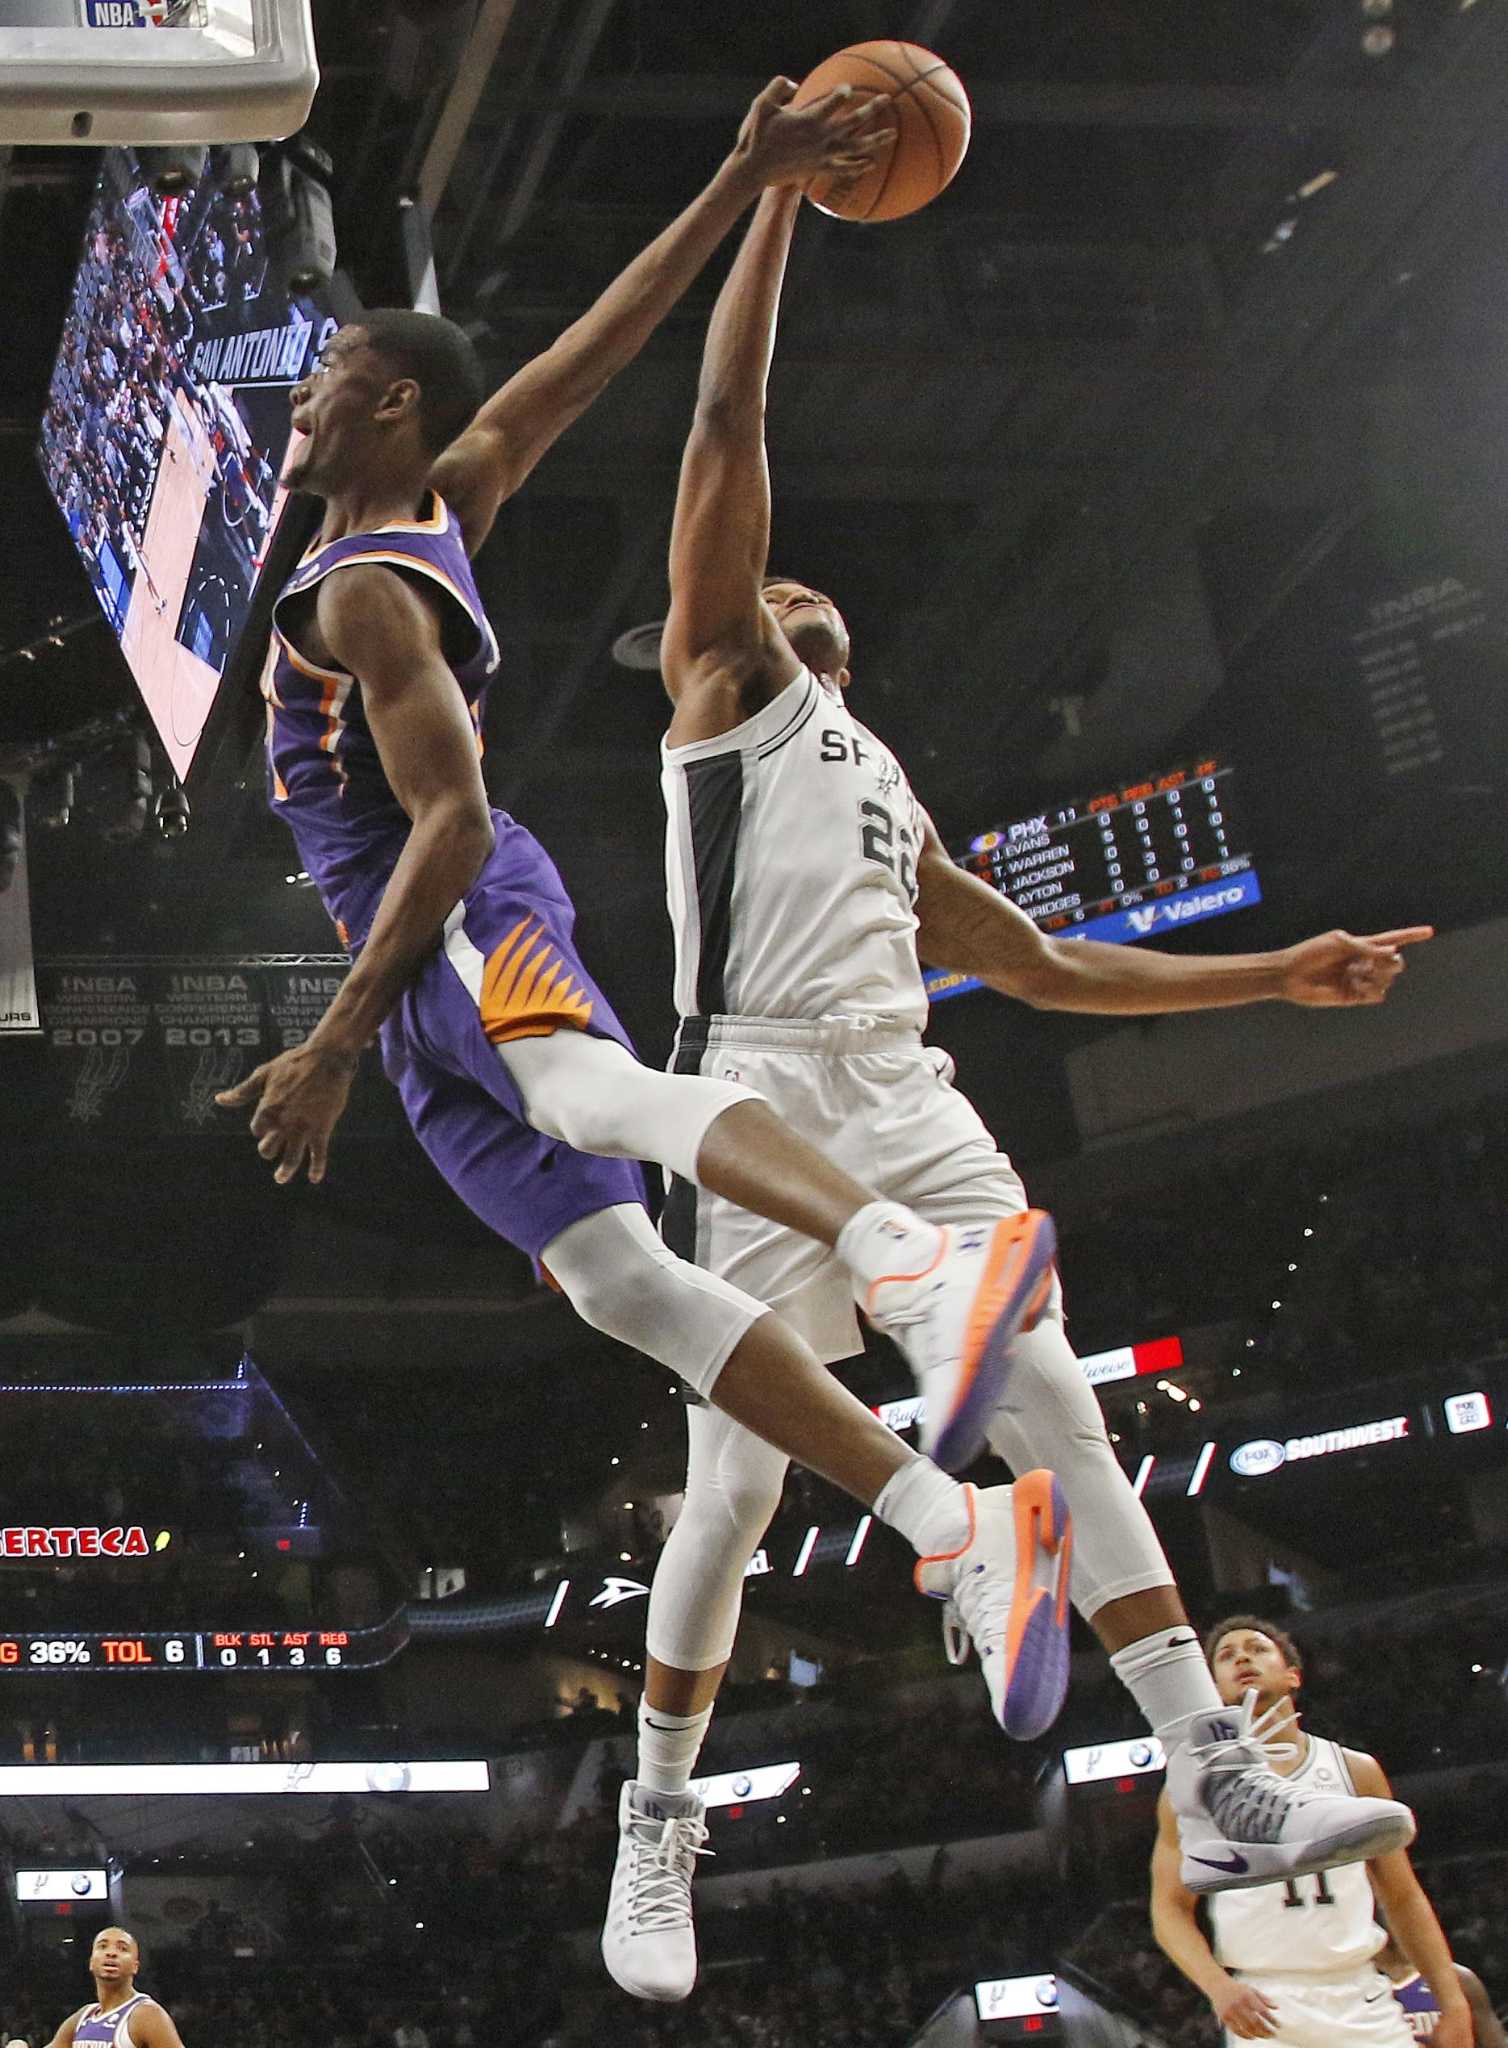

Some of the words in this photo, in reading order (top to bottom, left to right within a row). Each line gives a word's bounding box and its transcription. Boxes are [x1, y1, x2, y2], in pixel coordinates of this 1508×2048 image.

[95, 3, 135, 26] NBA
[219, 321, 313, 379] ANTONIO
[1008, 816, 1048, 840] PHX
[1005, 833, 1050, 857] EVANS
[1008, 844, 1069, 873] WARREN
[1012, 860, 1074, 890] JACKSON
[1018, 881, 1062, 905] AYTON
[1163, 885, 1244, 921] Valero
[52, 1029, 145, 1046] 2007
[166, 1028, 260, 1046] 2013
[1285, 1416, 1409, 1462] SOUTHWEST
[0, 1527, 149, 1556] ERTECA
[215, 1634, 242, 1646] BLK
[250, 1634, 275, 1646] STL
[283, 1634, 310, 1645] AST
[320, 1633, 347, 1645] REB
[29, 1641, 91, 1664] 36%
[101, 1641, 152, 1663] TOL
[165, 1641, 184, 1663] 6
[220, 1648, 237, 1666] 0
[257, 1648, 270, 1666] 1
[289, 1648, 305, 1665] 3
[325, 1647, 341, 1665] 6
